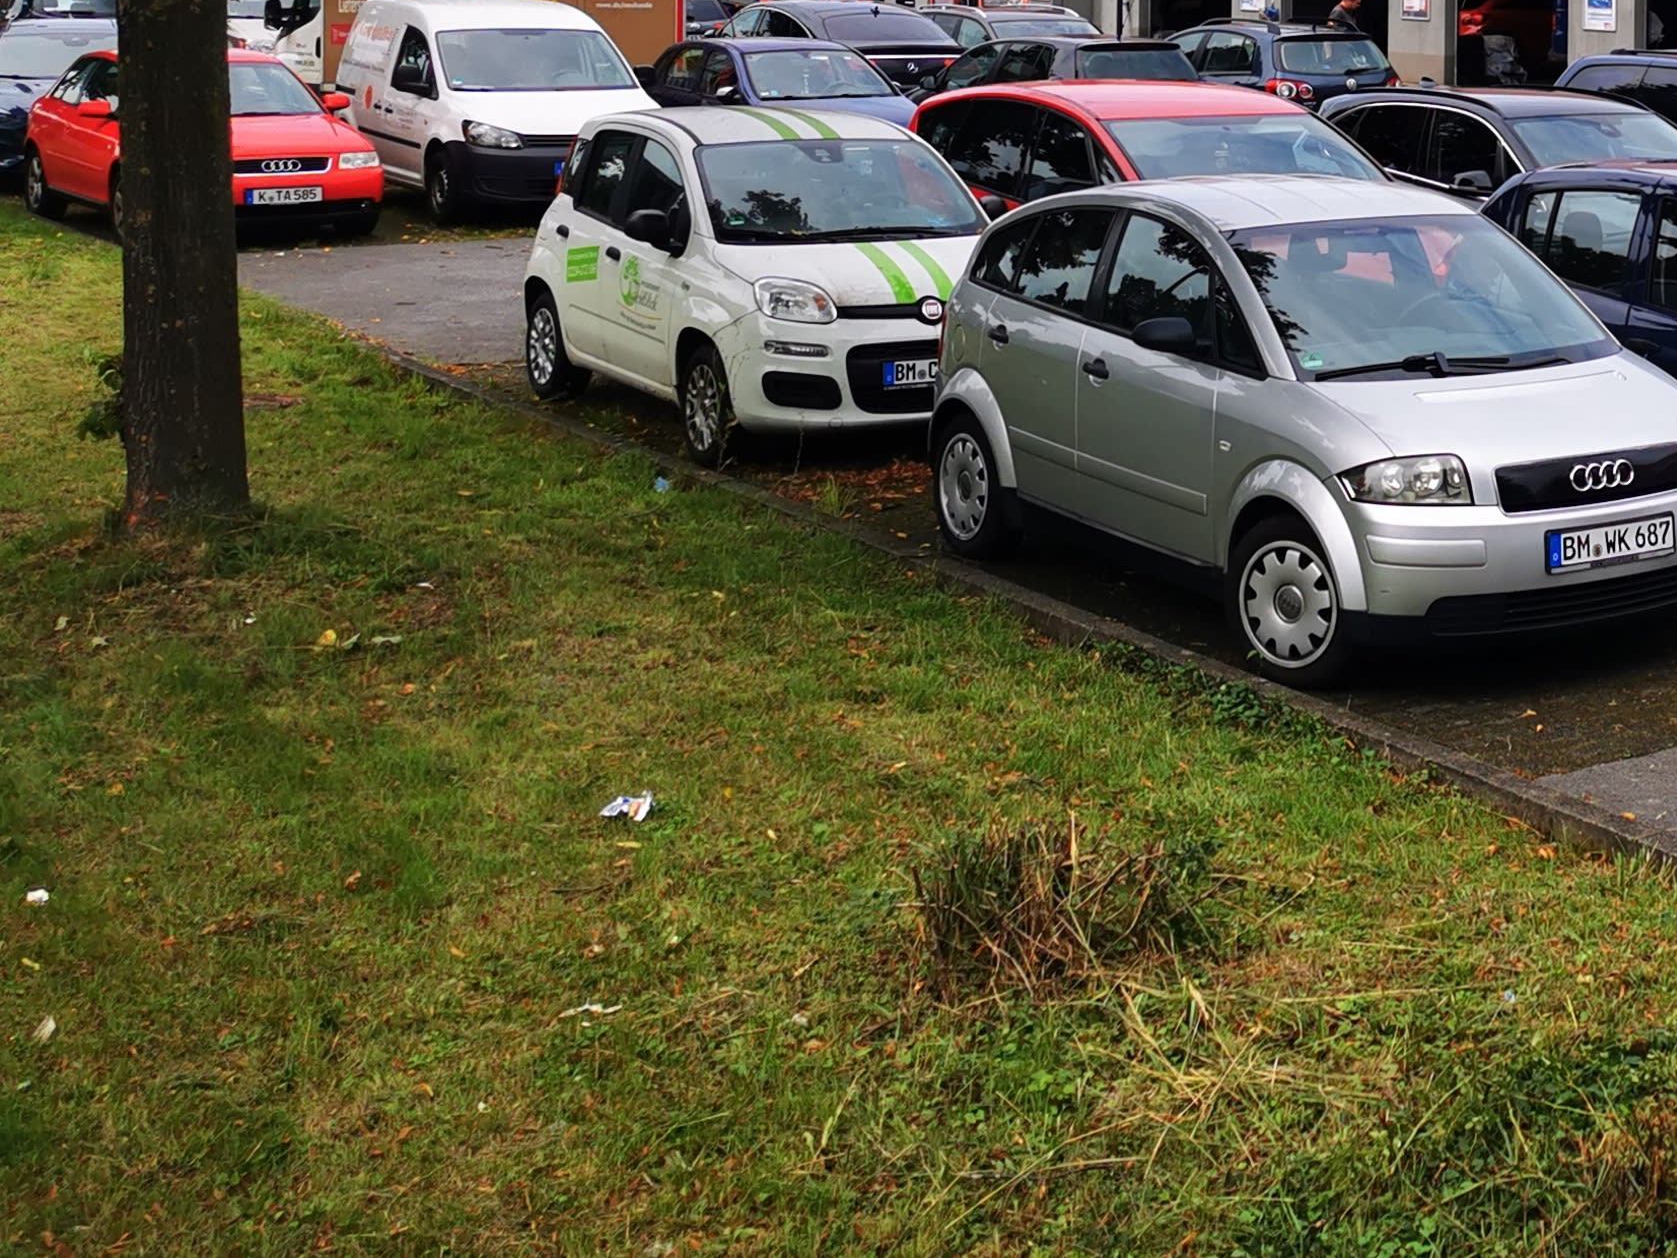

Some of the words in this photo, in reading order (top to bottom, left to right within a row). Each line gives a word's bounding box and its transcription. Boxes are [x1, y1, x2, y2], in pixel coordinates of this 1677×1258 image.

[258, 192, 267, 202] K
[275, 190, 292, 201] TA
[294, 189, 317, 200] 585
[895, 363, 916, 382] BM
[1563, 534, 1590, 561] BM
[1605, 527, 1631, 554] WK
[1635, 520, 1670, 548] 687
